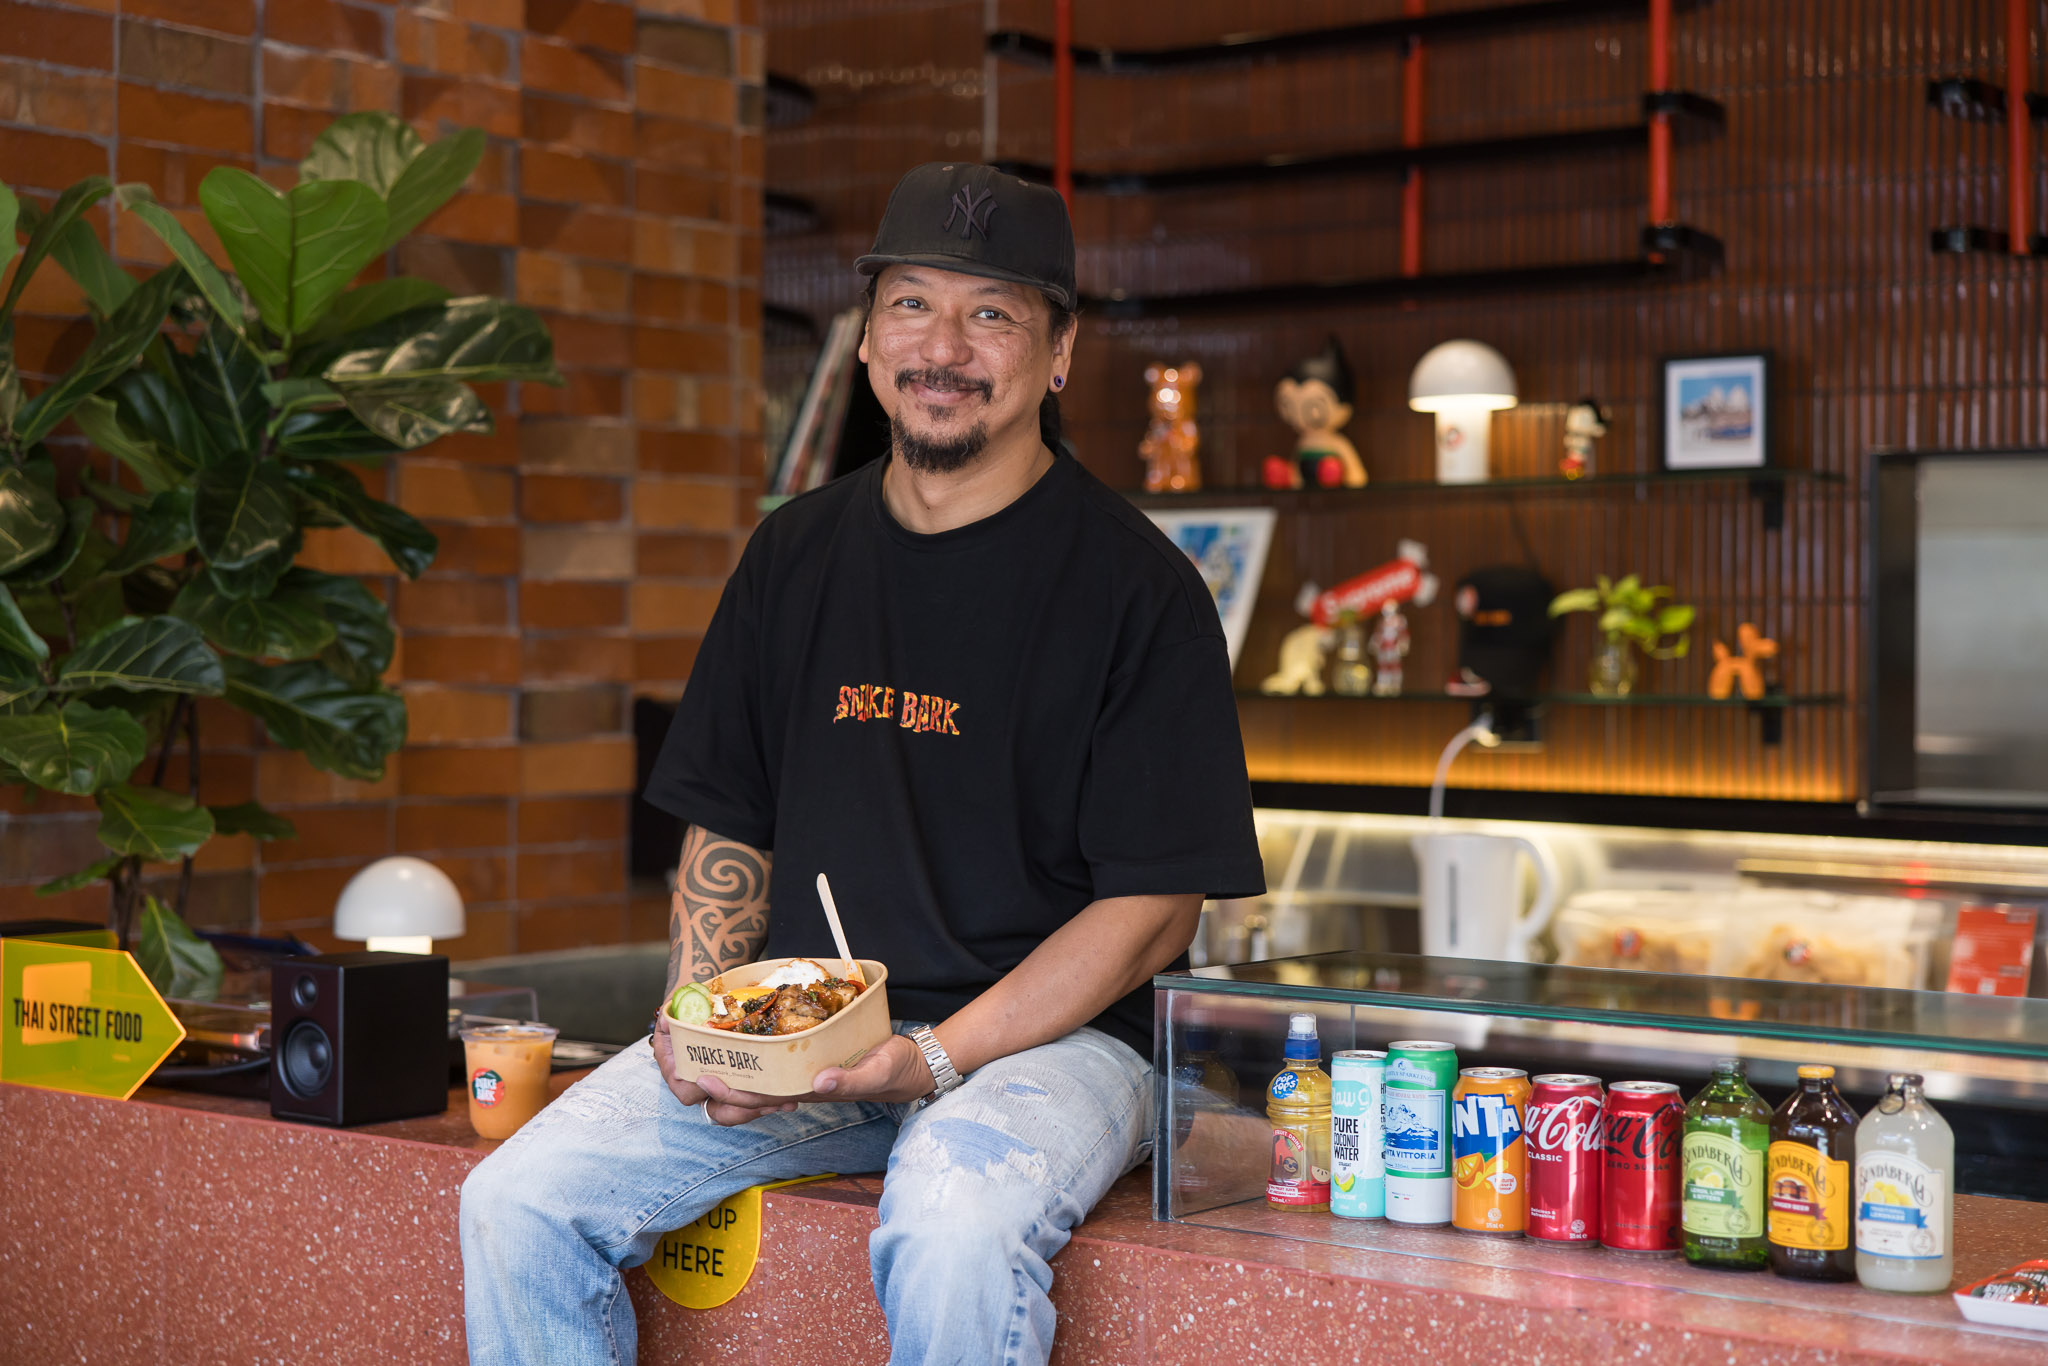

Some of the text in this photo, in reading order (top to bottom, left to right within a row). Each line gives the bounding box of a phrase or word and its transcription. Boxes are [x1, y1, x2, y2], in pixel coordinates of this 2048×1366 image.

[943, 184, 1000, 241] NY
[833, 683, 961, 735] SNAKE BARK
[13, 998, 143, 1042] THAI STREET FOOD
[686, 1045, 763, 1072] SNAKE BARK
[1272, 1080, 1297, 1095] TOPS
[1275, 1074, 1294, 1086] POP
[1333, 1117, 1359, 1134] PURE
[1288, 1133, 1302, 1150] DRINK
[1333, 1132, 1360, 1148] COCONUT
[1333, 1147, 1360, 1162] WATER
[1396, 1150, 1436, 1160] VITTORIA
[1527, 1151, 1563, 1163] CLASSIC
[707, 1207, 737, 1231] UP
[663, 1240, 724, 1277] HERE
